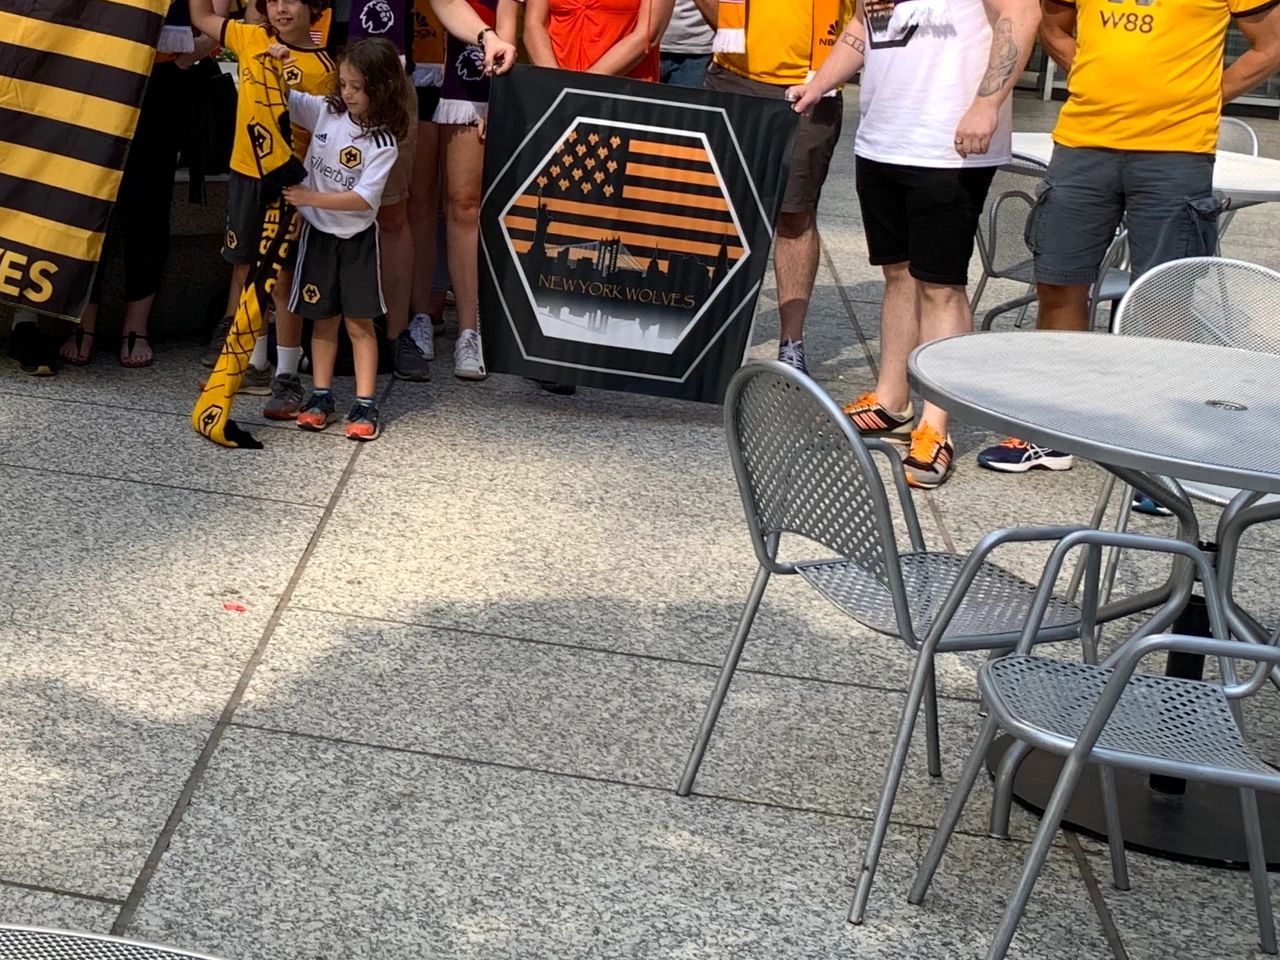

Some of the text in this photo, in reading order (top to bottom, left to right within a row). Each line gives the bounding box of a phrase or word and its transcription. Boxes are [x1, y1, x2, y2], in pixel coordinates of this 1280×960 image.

[1099, 10, 1154, 33] W88
[538, 274, 696, 309] NEW YORK WOLVES
